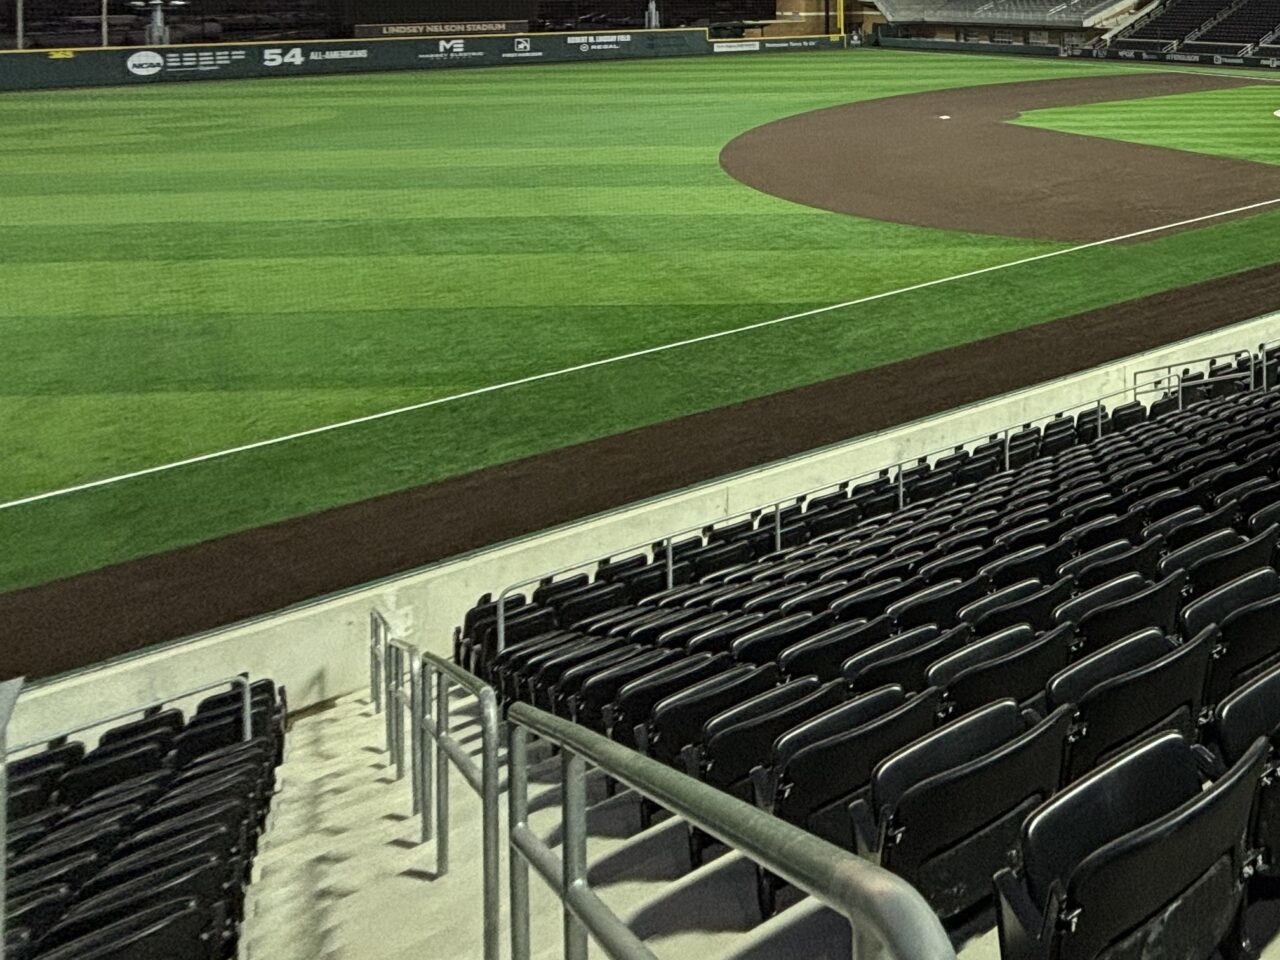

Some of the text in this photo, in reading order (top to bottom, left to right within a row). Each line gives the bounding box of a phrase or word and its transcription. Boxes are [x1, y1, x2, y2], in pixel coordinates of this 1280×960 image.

[382, 23, 506, 34] LINDSEY NELSON STADIUM
[263, 47, 305, 66] 54
[309, 49, 368, 60] ALL-AMERICANS
